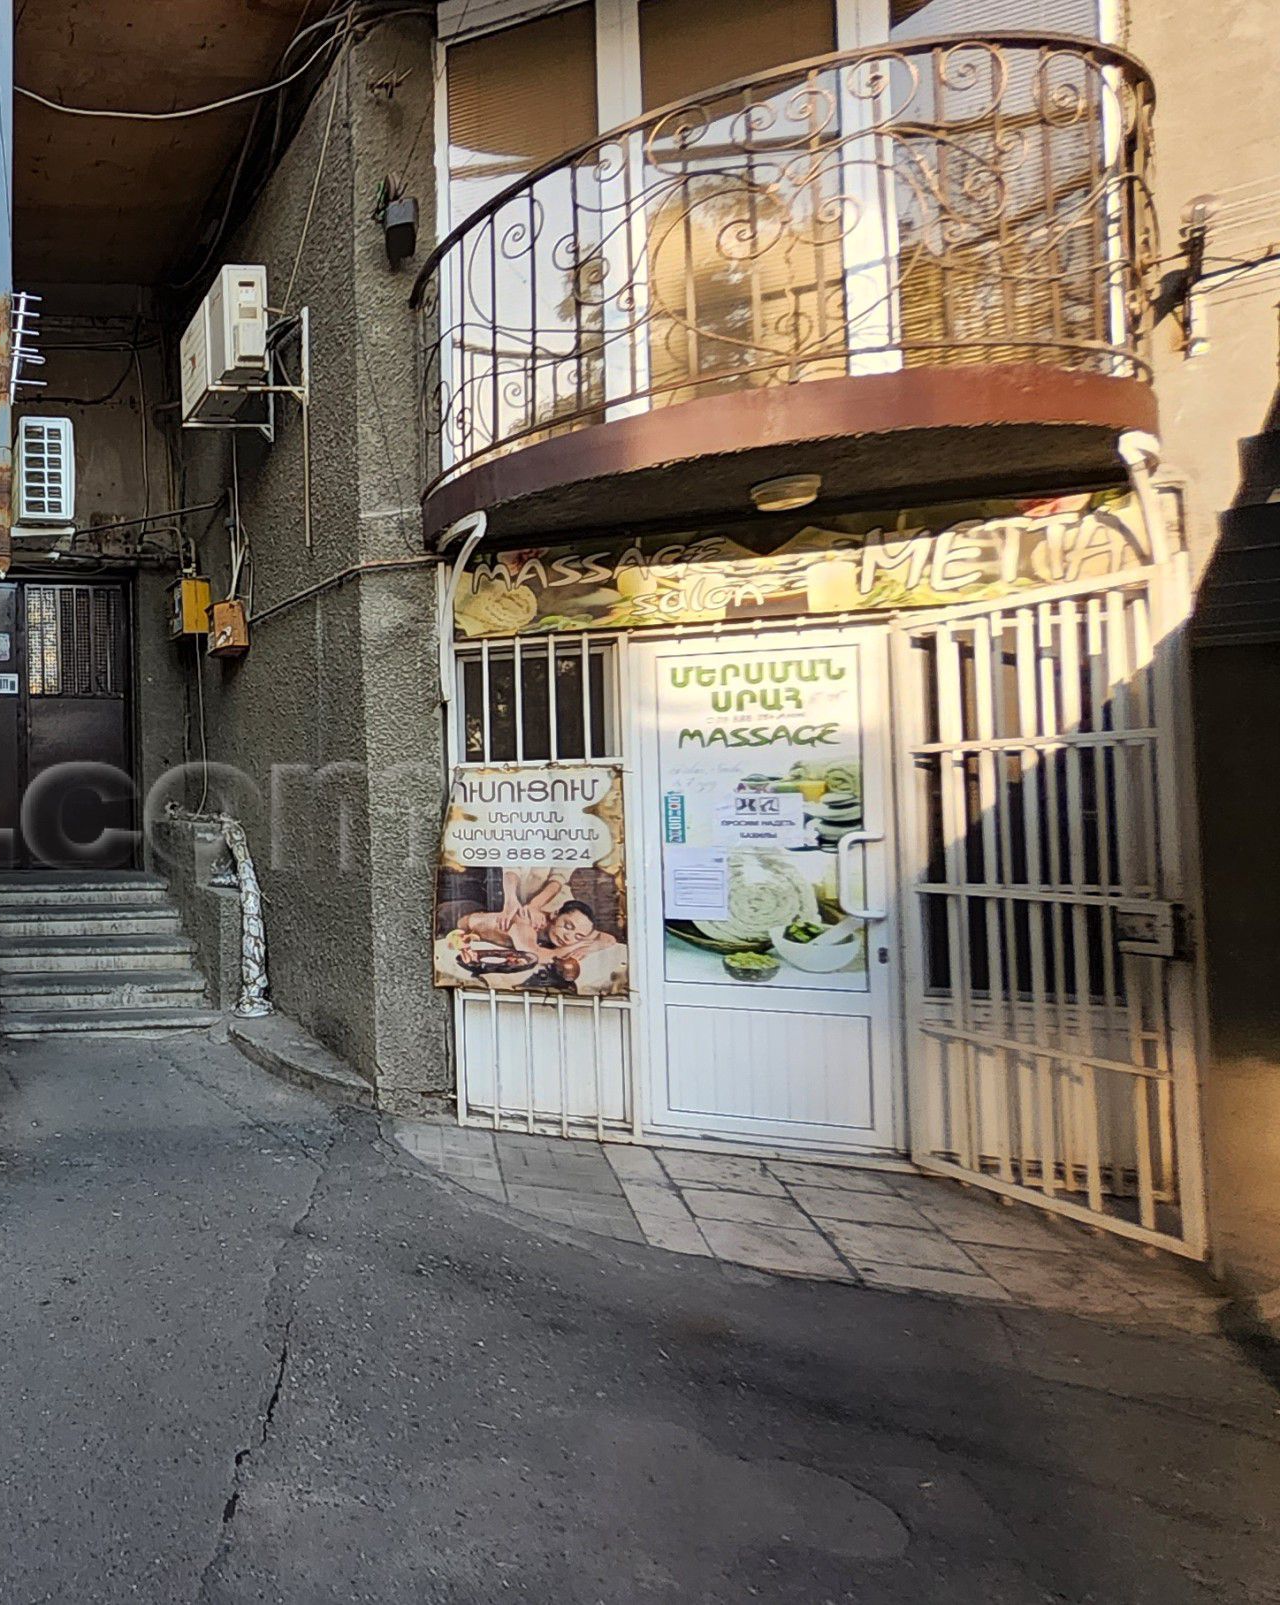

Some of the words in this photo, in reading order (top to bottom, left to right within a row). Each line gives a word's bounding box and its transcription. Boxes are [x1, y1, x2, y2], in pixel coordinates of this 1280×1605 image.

[472, 536, 726, 594] MASSAGE
[860, 512, 1125, 594] METTA
[631, 574, 765, 616] salon
[671, 658, 846, 688] ՄԵՐՍՄԱՆ
[711, 687, 804, 713] ՍՐԱՀ
[678, 722, 842, 749] MASSAGE
[488, 811, 564, 824] ՄԵՐՍՄԱՆ
[462, 848, 502, 861] 099
[506, 848, 547, 861] 888
[551, 848, 592, 861] 224
